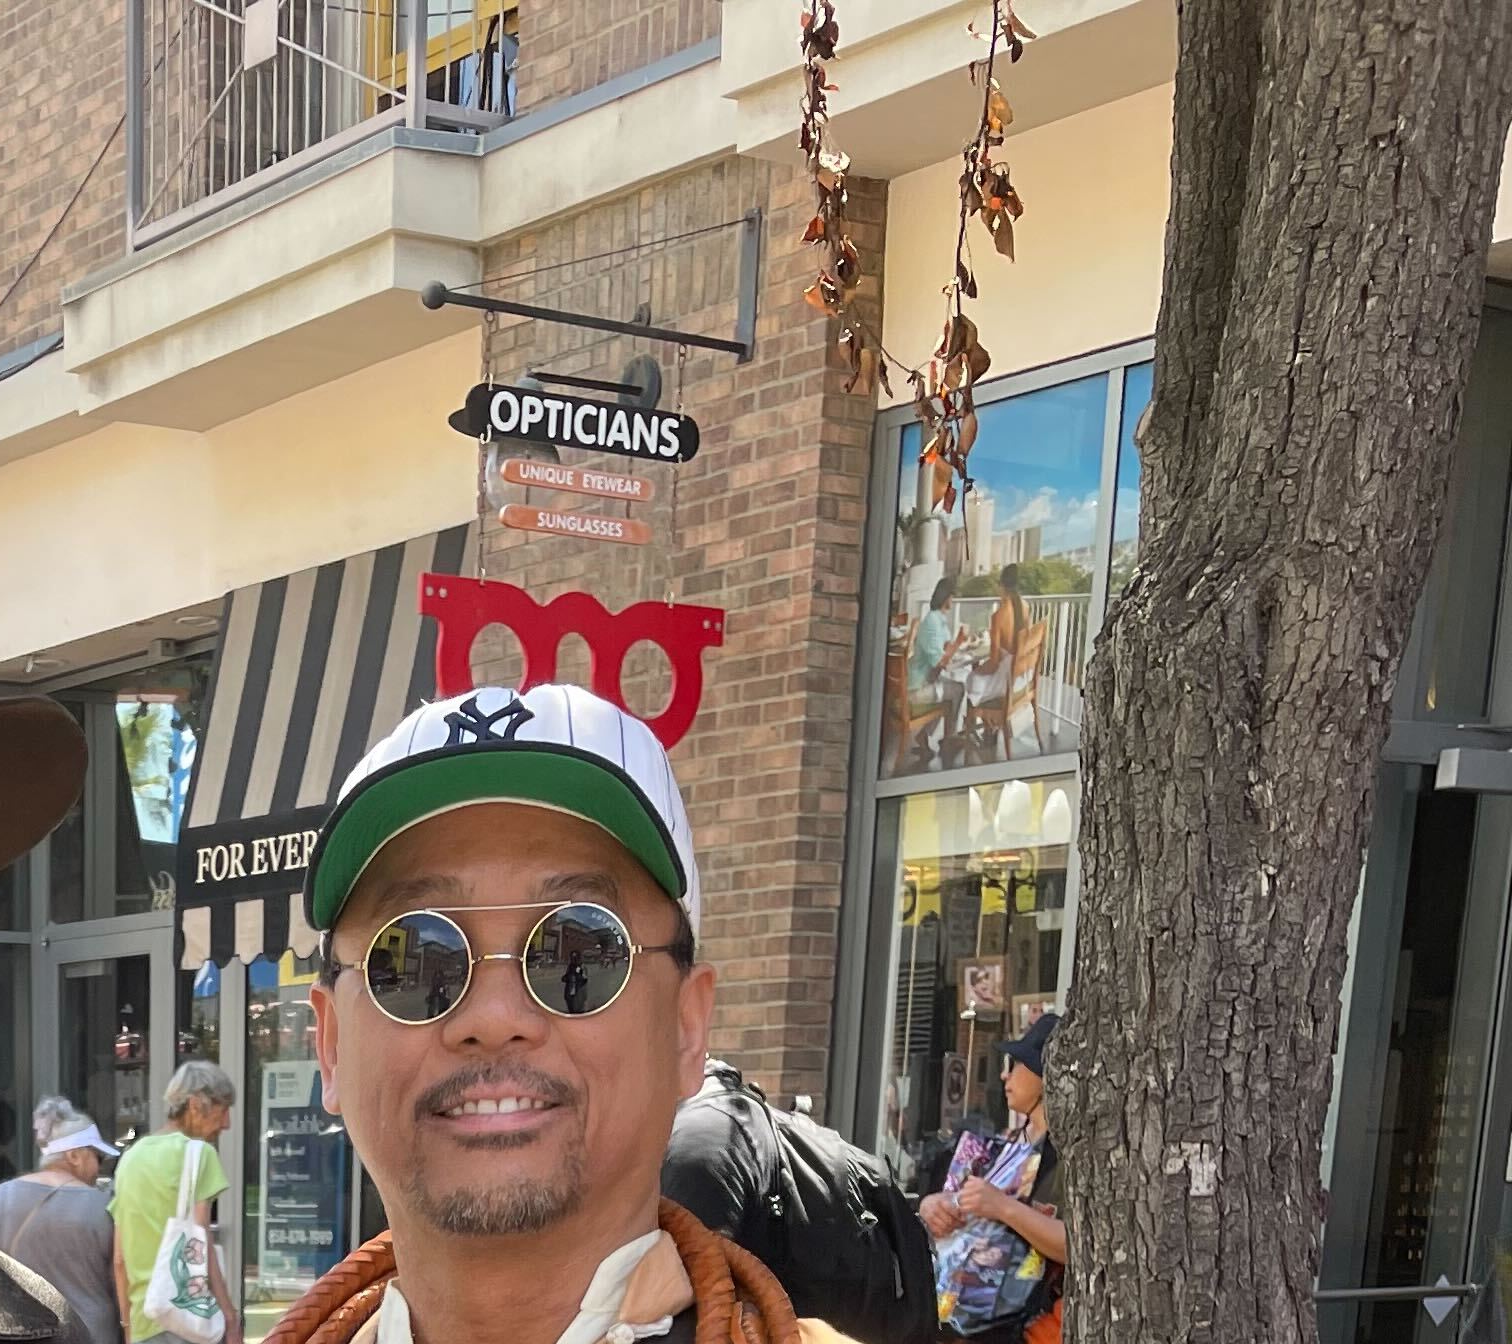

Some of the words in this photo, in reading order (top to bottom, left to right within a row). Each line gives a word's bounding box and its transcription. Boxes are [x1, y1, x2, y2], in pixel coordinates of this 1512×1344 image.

[490, 390, 680, 457] OPTICIANS
[519, 463, 574, 485] UNIQUE
[582, 473, 641, 495] EYEWEAR
[537, 511, 623, 537] SUNGLASSES
[195, 843, 247, 883] FOR
[251, 829, 324, 875] EVER
